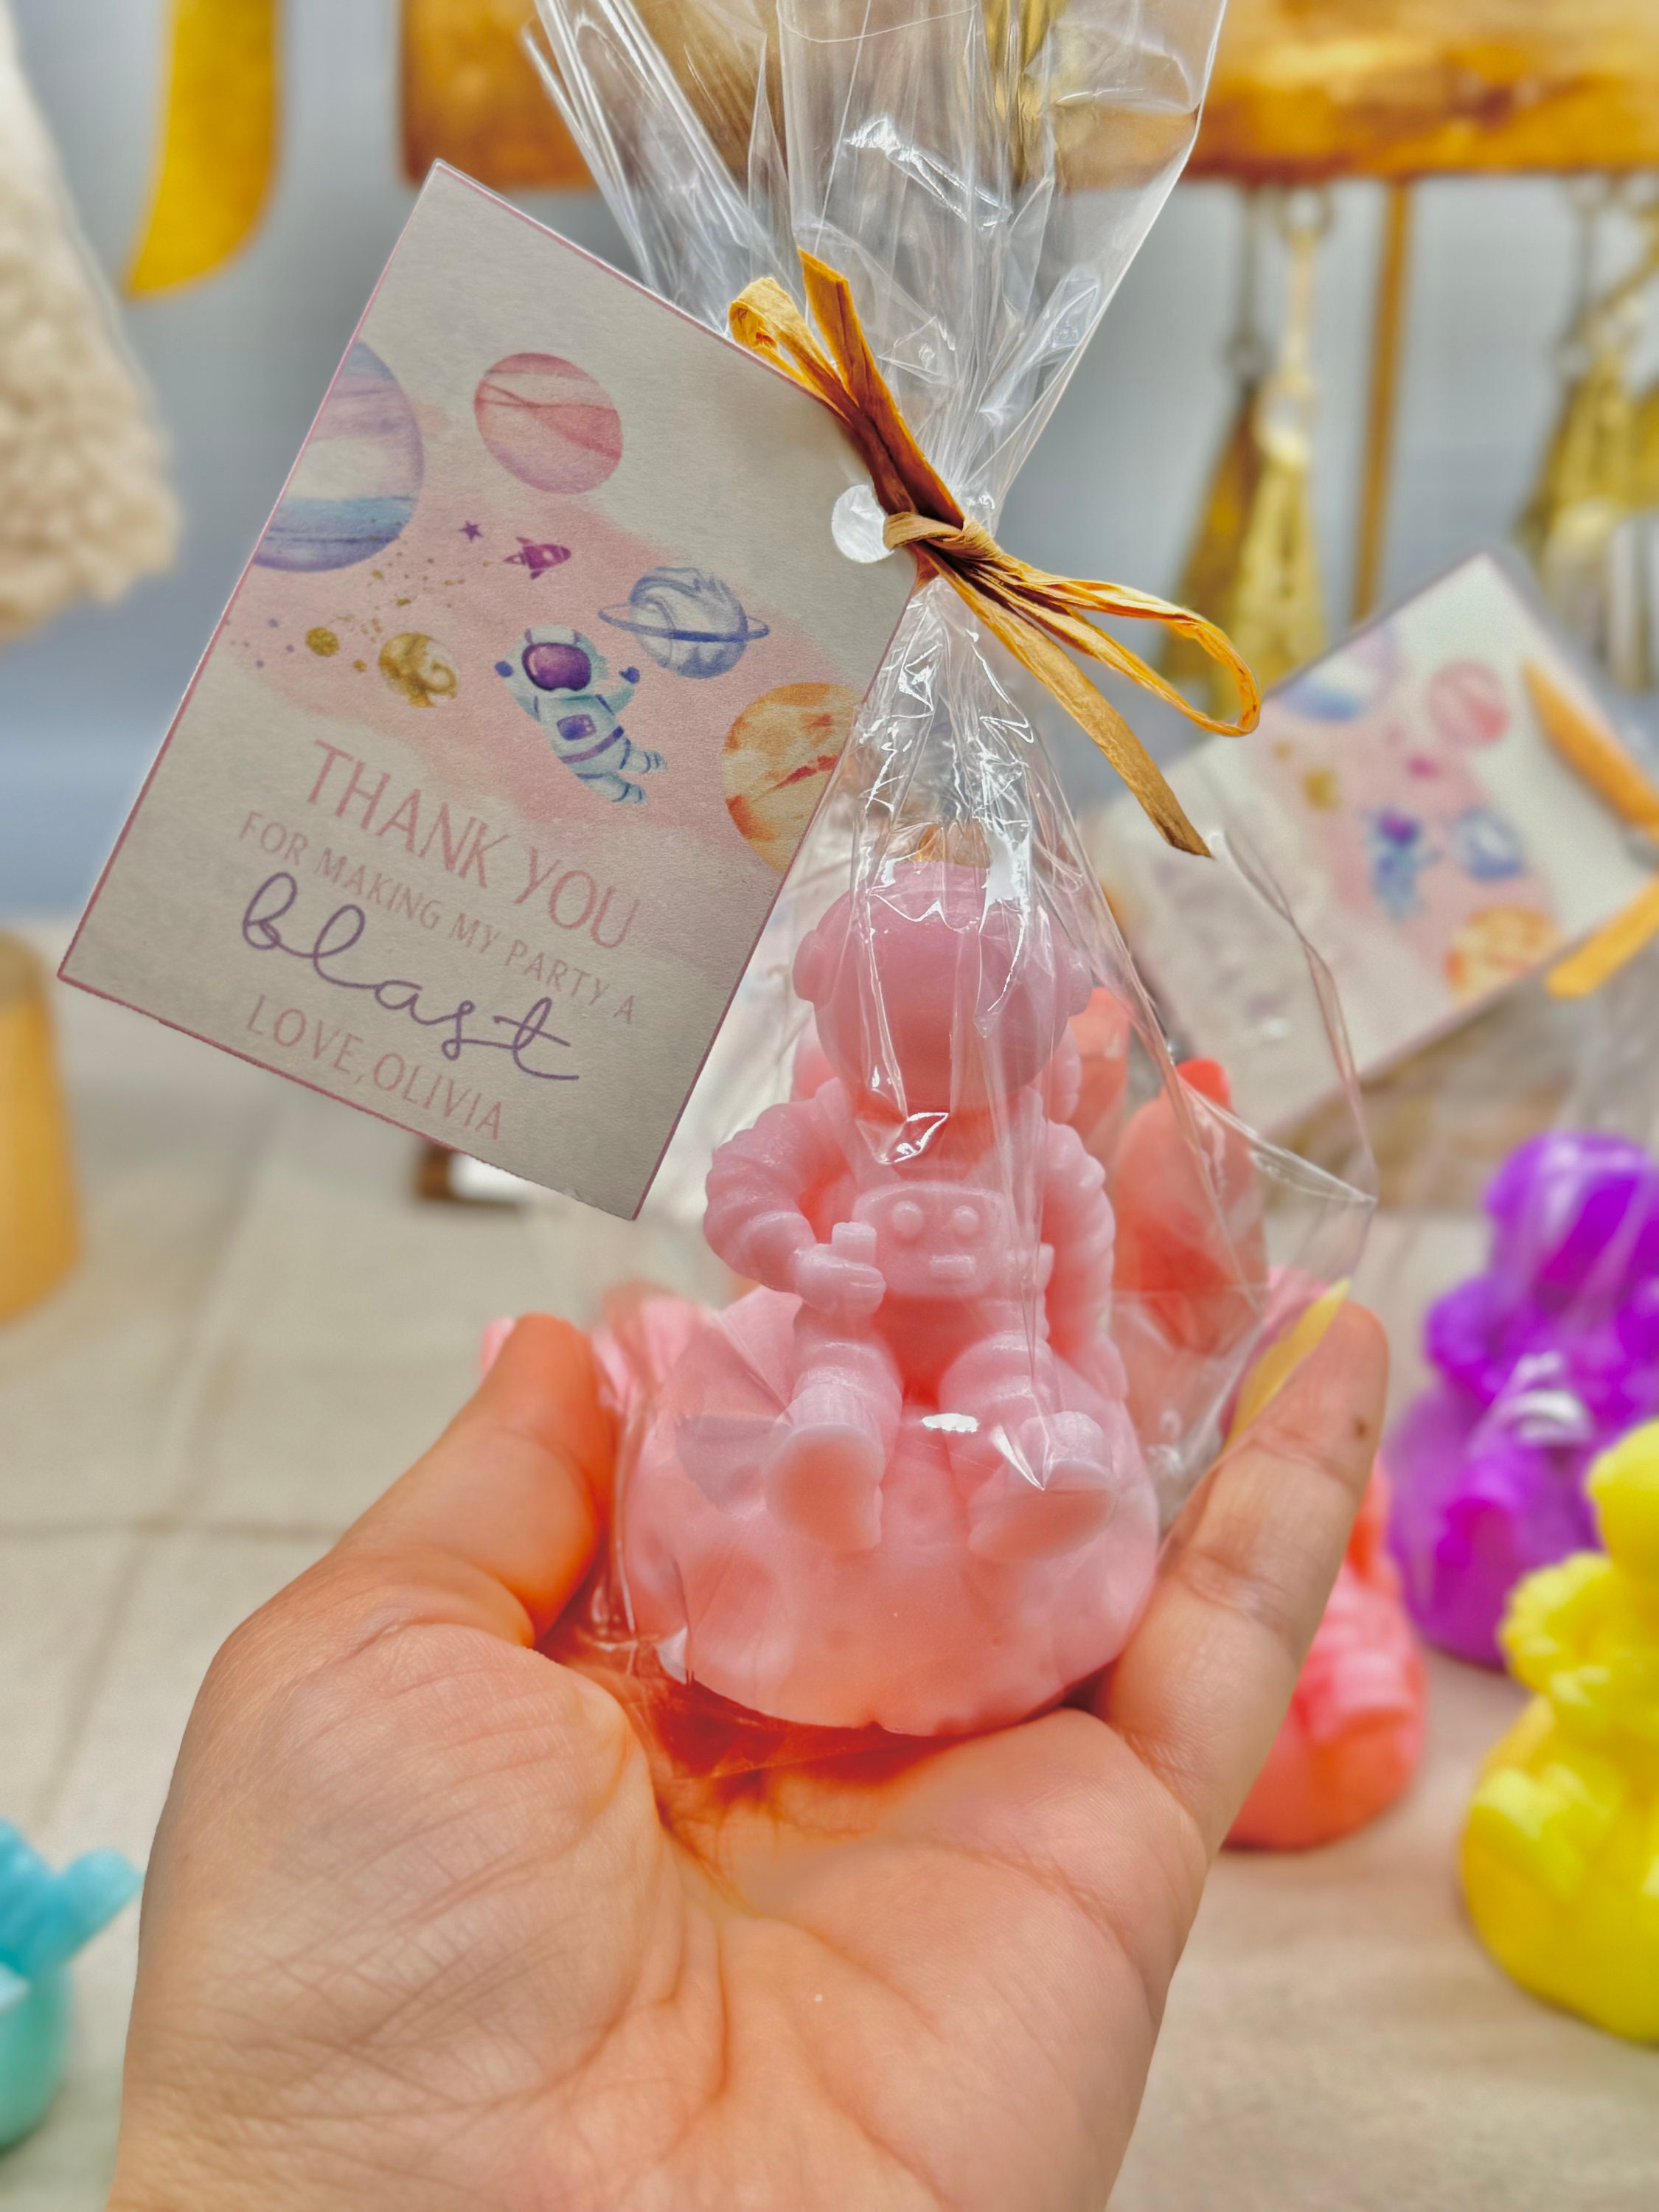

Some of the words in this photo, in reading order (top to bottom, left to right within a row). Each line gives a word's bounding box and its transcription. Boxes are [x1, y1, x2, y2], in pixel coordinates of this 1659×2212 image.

[239, 811, 308, 865] FOR
[314, 848, 441, 930] MAKING
[448, 913, 500, 954] MY
[506, 939, 611, 1006] PARTY
[613, 995, 636, 1024] A
[307, 739, 510, 888] THANK
[513, 847, 639, 948] YOU
[243, 872, 579, 1080] blast
